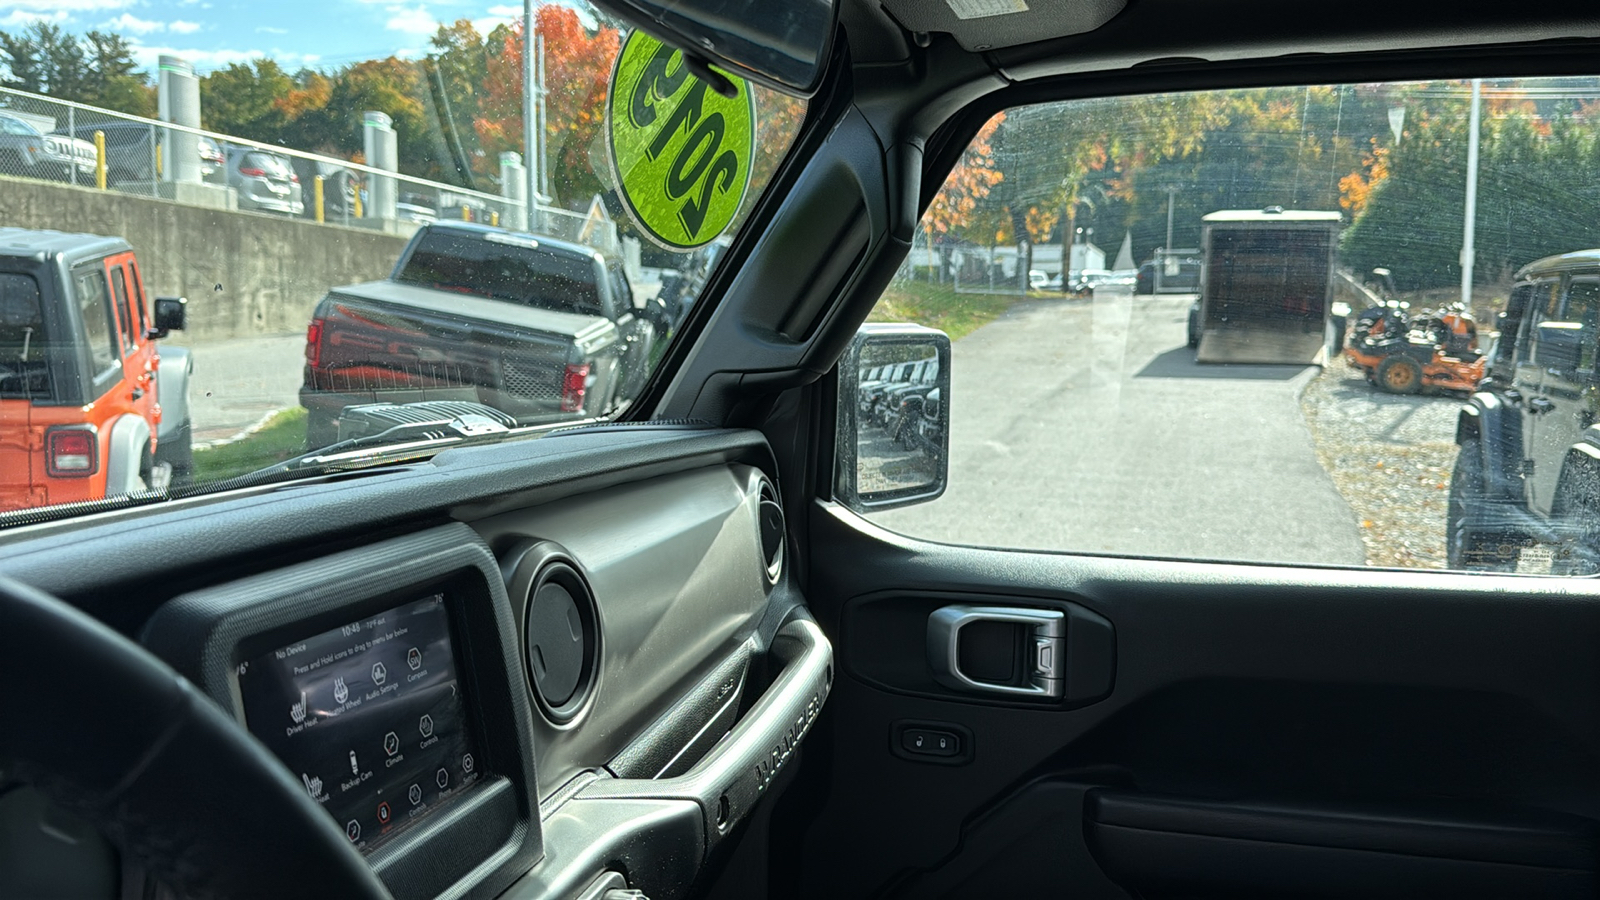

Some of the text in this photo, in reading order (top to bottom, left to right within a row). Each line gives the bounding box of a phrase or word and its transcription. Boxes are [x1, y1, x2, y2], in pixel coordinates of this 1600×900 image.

[342, 624, 361, 637] 10:48
[276, 645, 307, 659] No Device
[294, 665, 309, 675] Press
[311, 660, 321, 669] and
[321, 655, 334, 665] Hold
[335, 651, 348, 660] icons
[355, 644, 366, 653] drag
[373, 638, 386, 647] menu
[385, 633, 394, 641] bar
[395, 628, 408, 638] below
[408, 670, 428, 682] Compass
[366, 683, 399, 700] Audio Settings
[346, 699, 362, 710] Wheel
[287, 718, 319, 737] Driver Heat
[420, 737, 439, 750] Controls
[386, 755, 404, 768] Climate
[341, 771, 374, 792] Backup Cam
